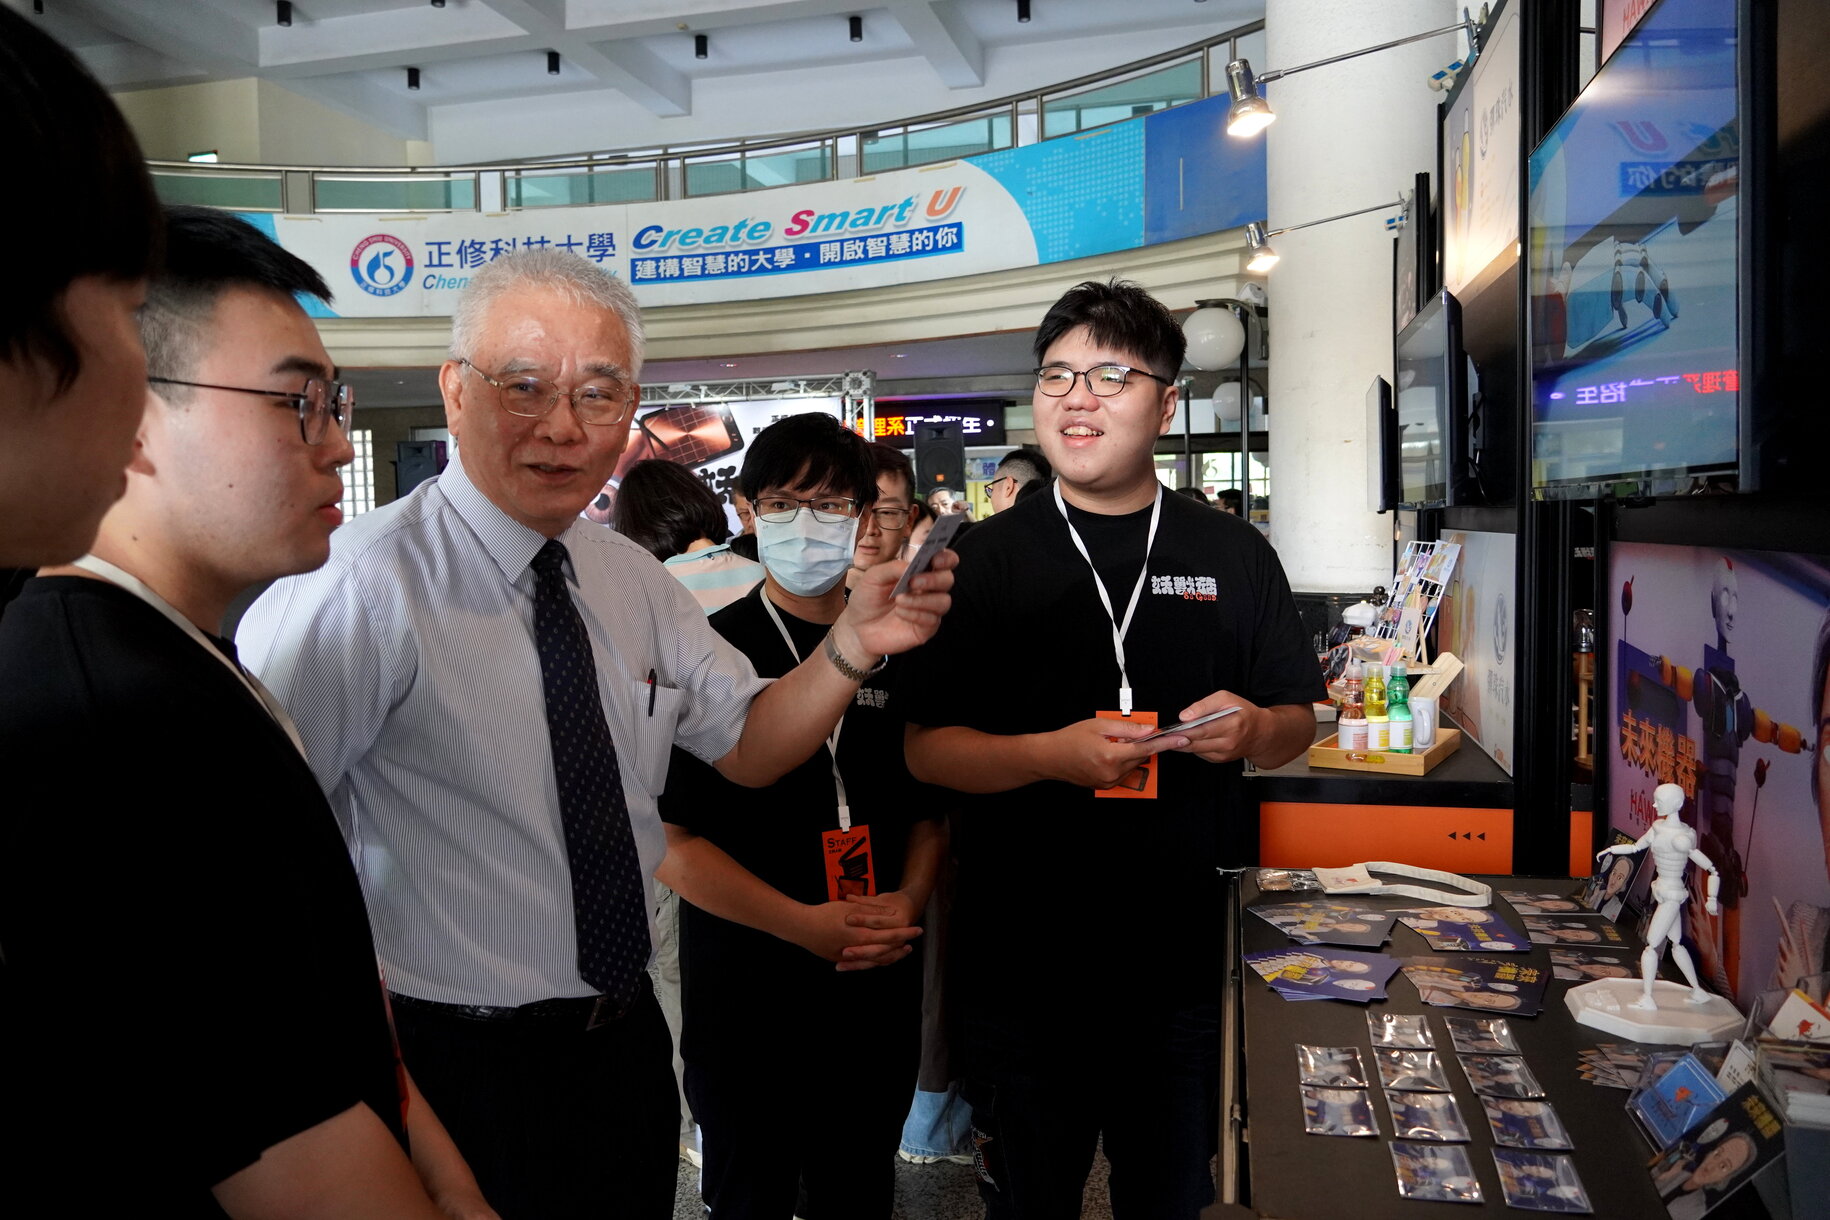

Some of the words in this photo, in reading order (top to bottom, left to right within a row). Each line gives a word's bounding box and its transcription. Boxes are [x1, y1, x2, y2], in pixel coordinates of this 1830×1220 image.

[632, 217, 772, 250] Create
[784, 195, 916, 237] Smart
[926, 185, 963, 218] U
[423, 274, 471, 290] Chen
